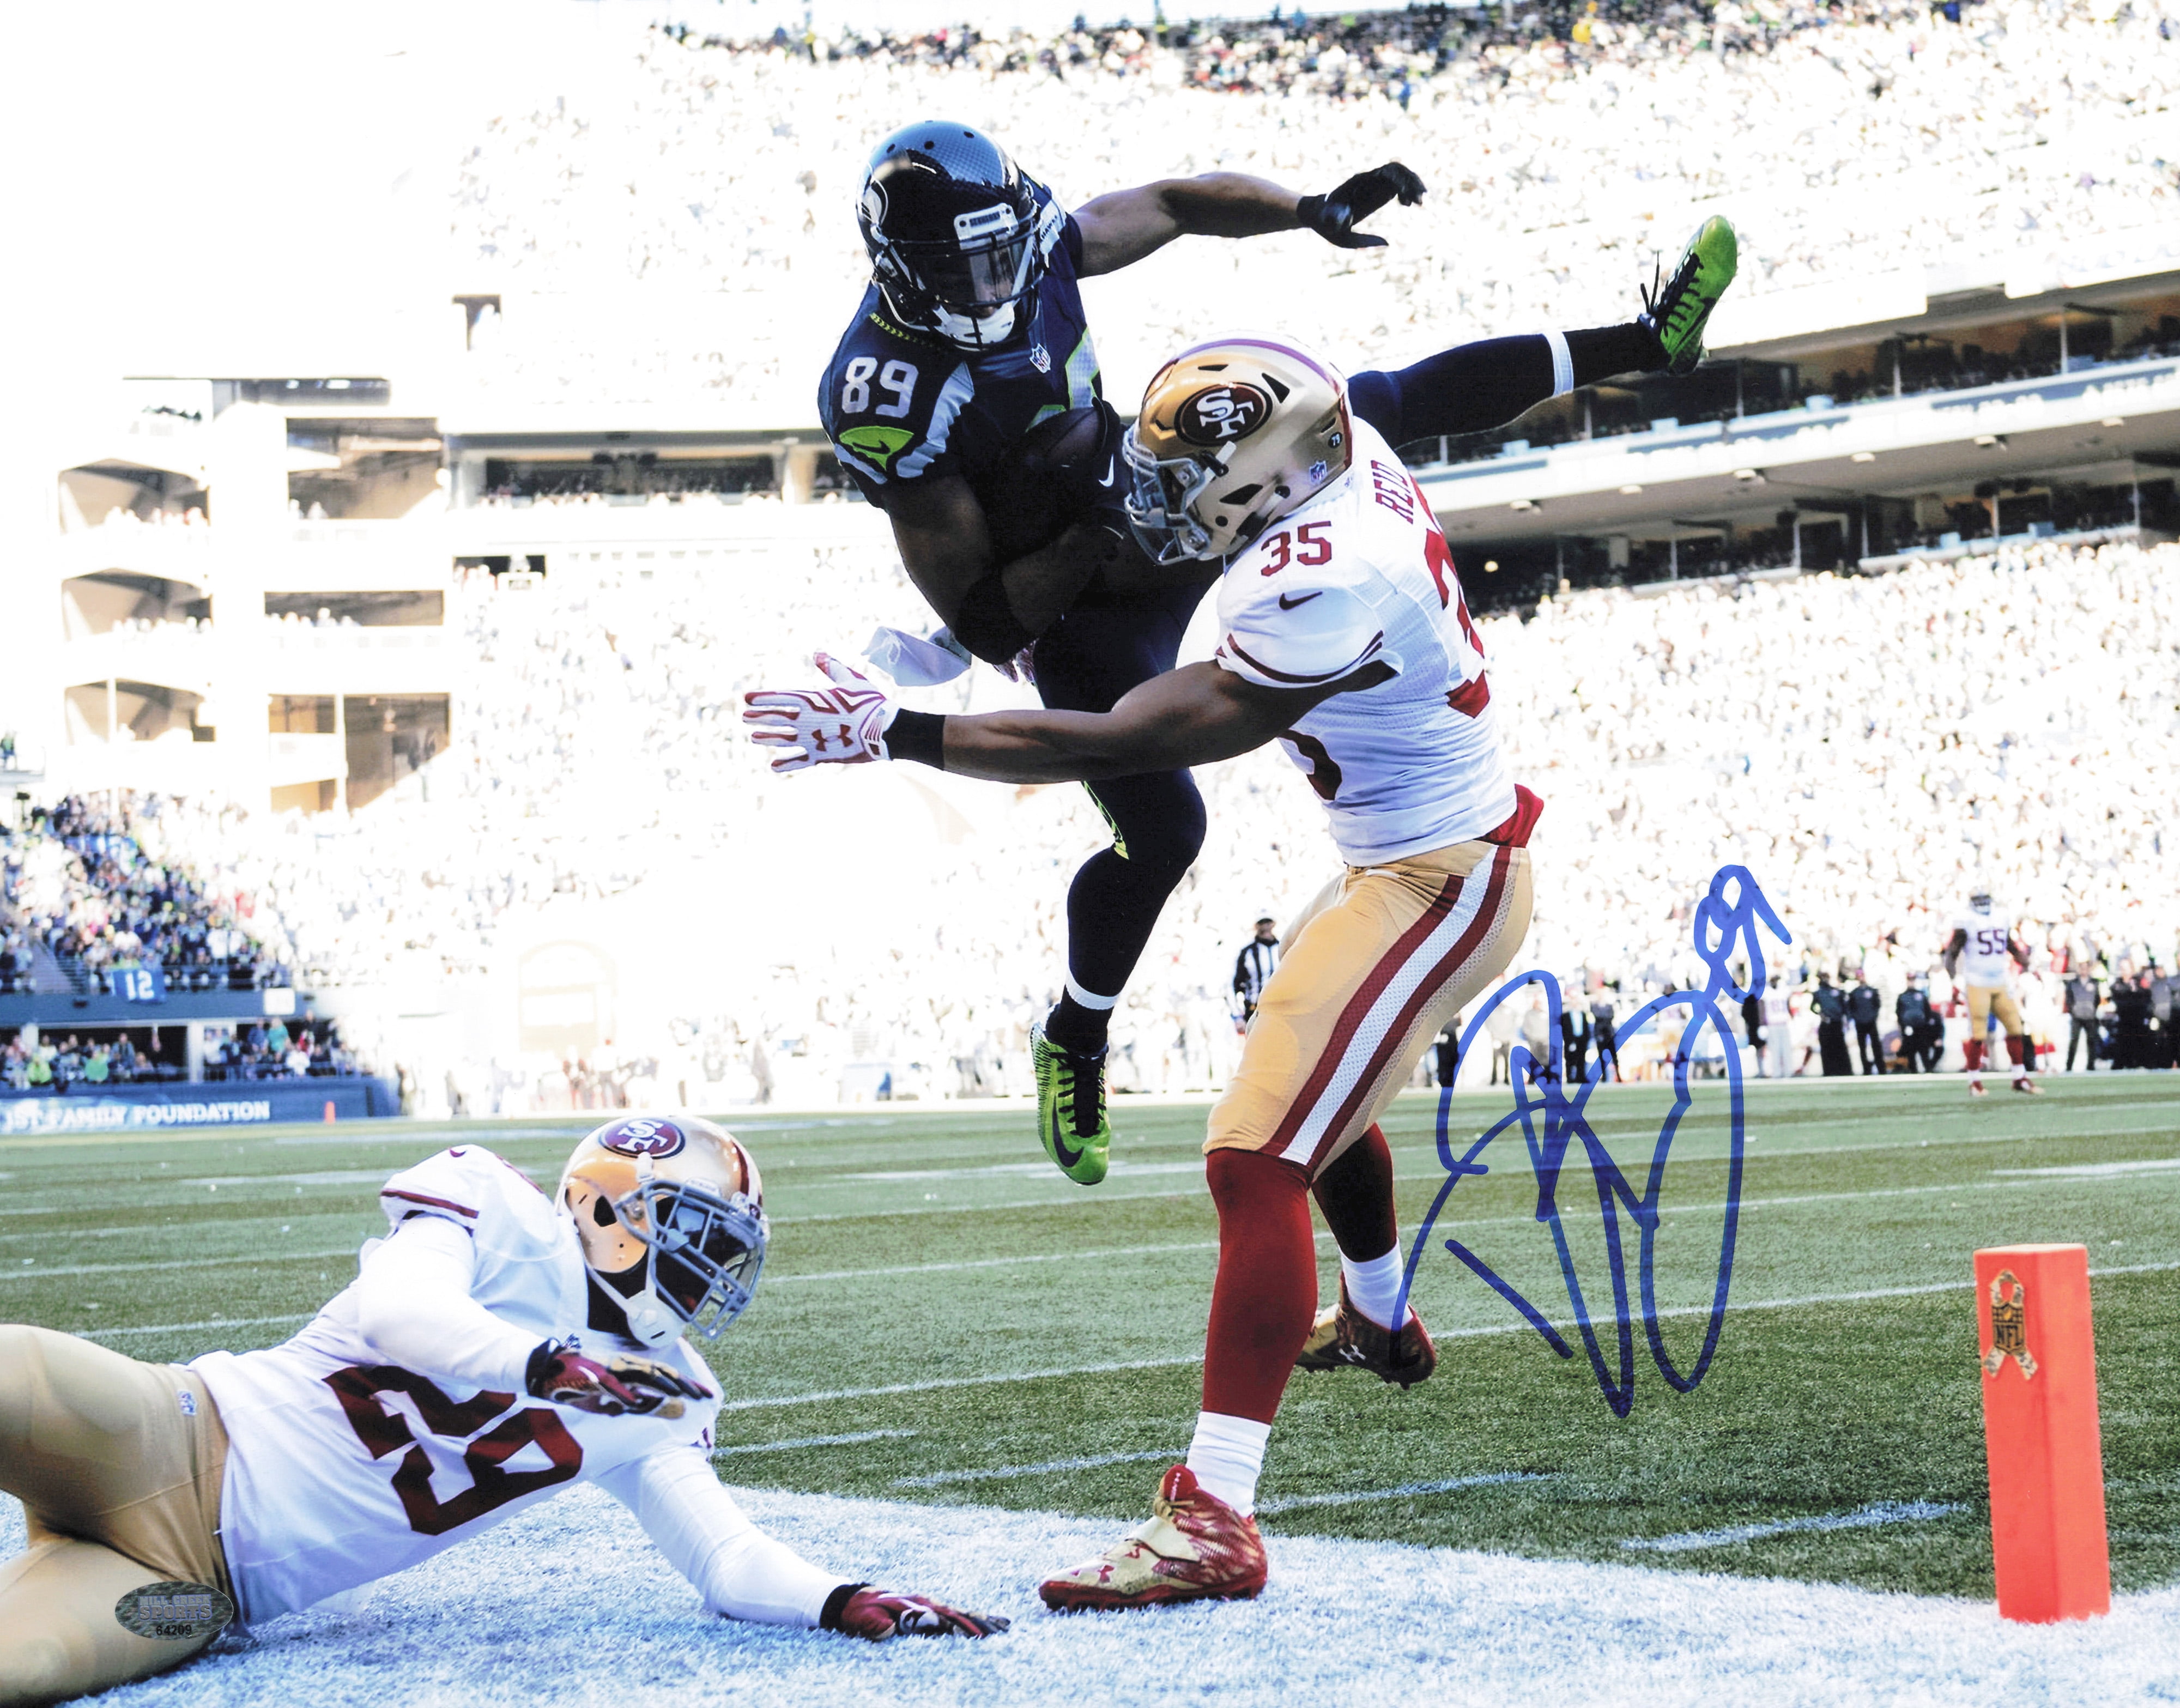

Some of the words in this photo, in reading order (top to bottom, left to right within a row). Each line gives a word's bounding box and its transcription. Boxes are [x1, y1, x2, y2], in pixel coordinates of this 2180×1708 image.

[841, 356, 919, 419] 89
[1196, 389, 1255, 438] SF
[1370, 459, 1414, 524] REID
[1261, 520, 1332, 577] 35
[1977, 929, 2006, 955] 55
[125, 971, 155, 1001] 12
[46, 1105, 128, 1130] FAMILY
[132, 1100, 270, 1126] FOUNDATION
[322, 1365, 584, 1536] 29
